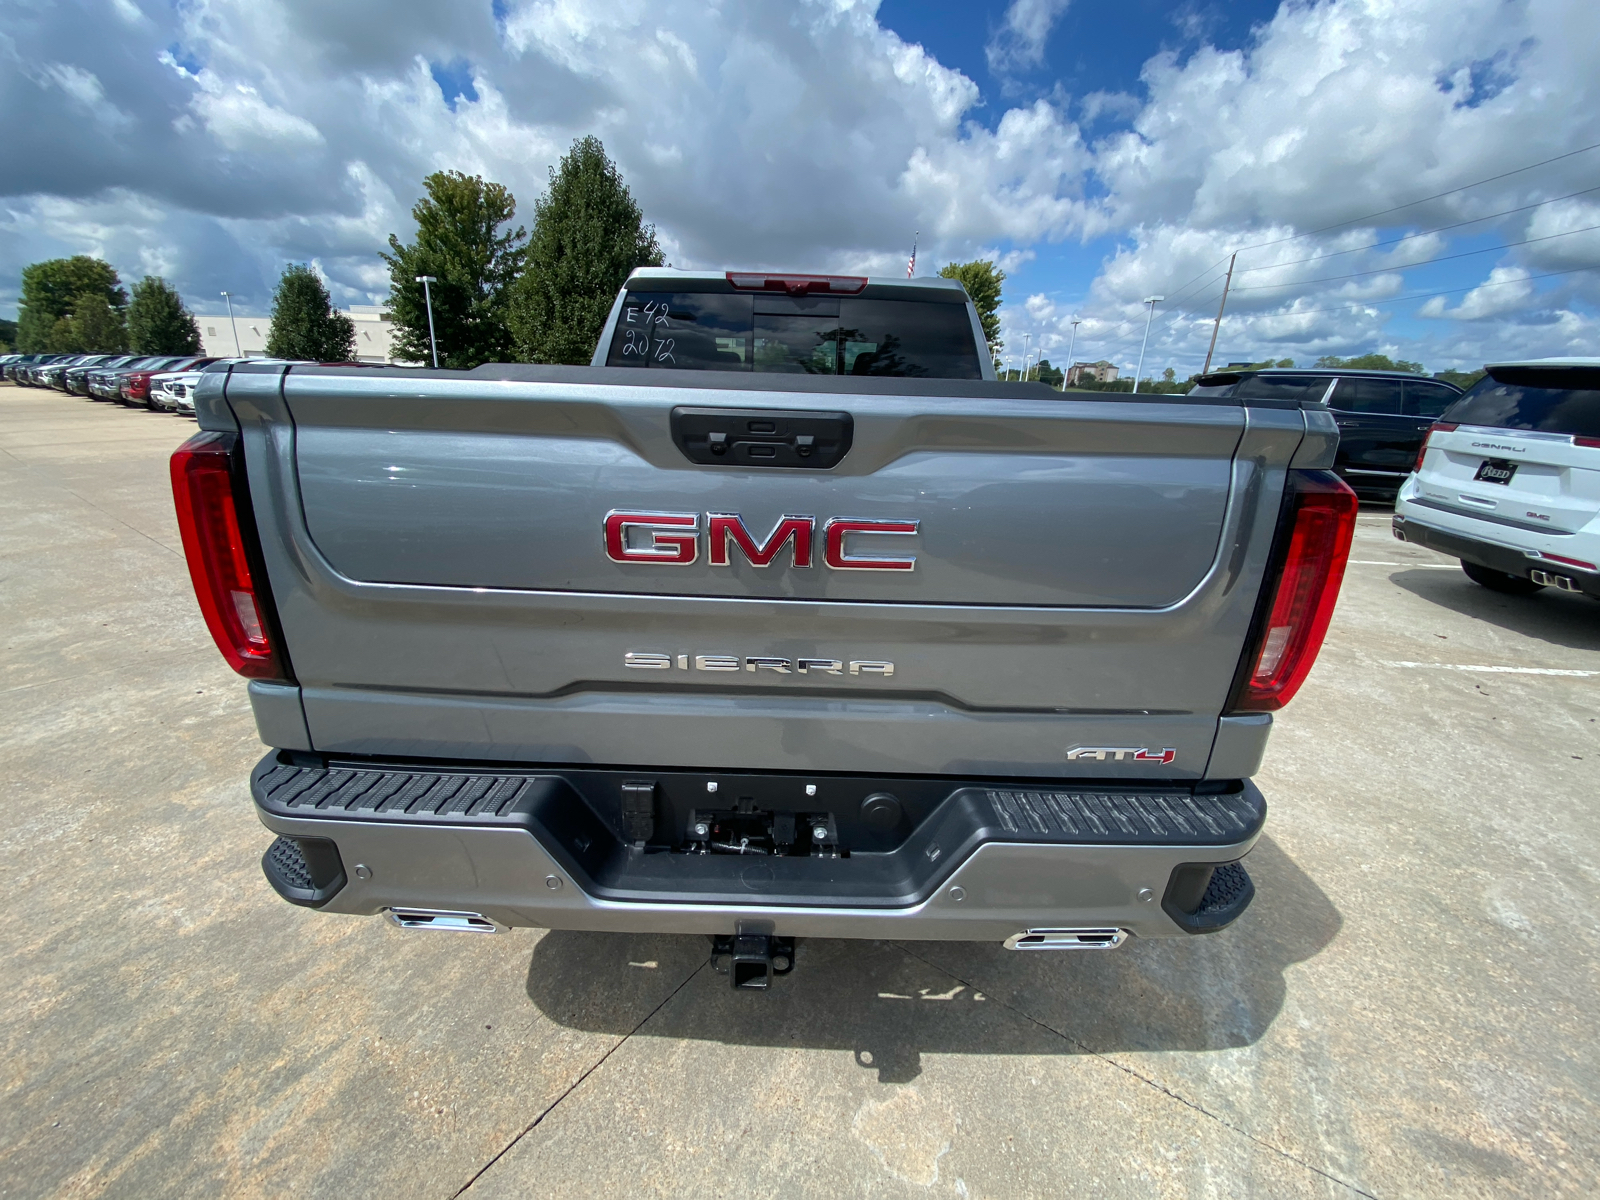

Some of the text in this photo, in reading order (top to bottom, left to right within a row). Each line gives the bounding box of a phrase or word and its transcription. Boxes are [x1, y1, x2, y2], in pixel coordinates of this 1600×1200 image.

[622, 330, 676, 364] 2072
[1471, 442, 1526, 452] DENALI
[1481, 465, 1510, 479] REED
[1526, 511, 1550, 521] GMC
[602, 508, 921, 572] GMC
[624, 652, 895, 677] SIERRA
[1066, 747, 1177, 765] AT4
